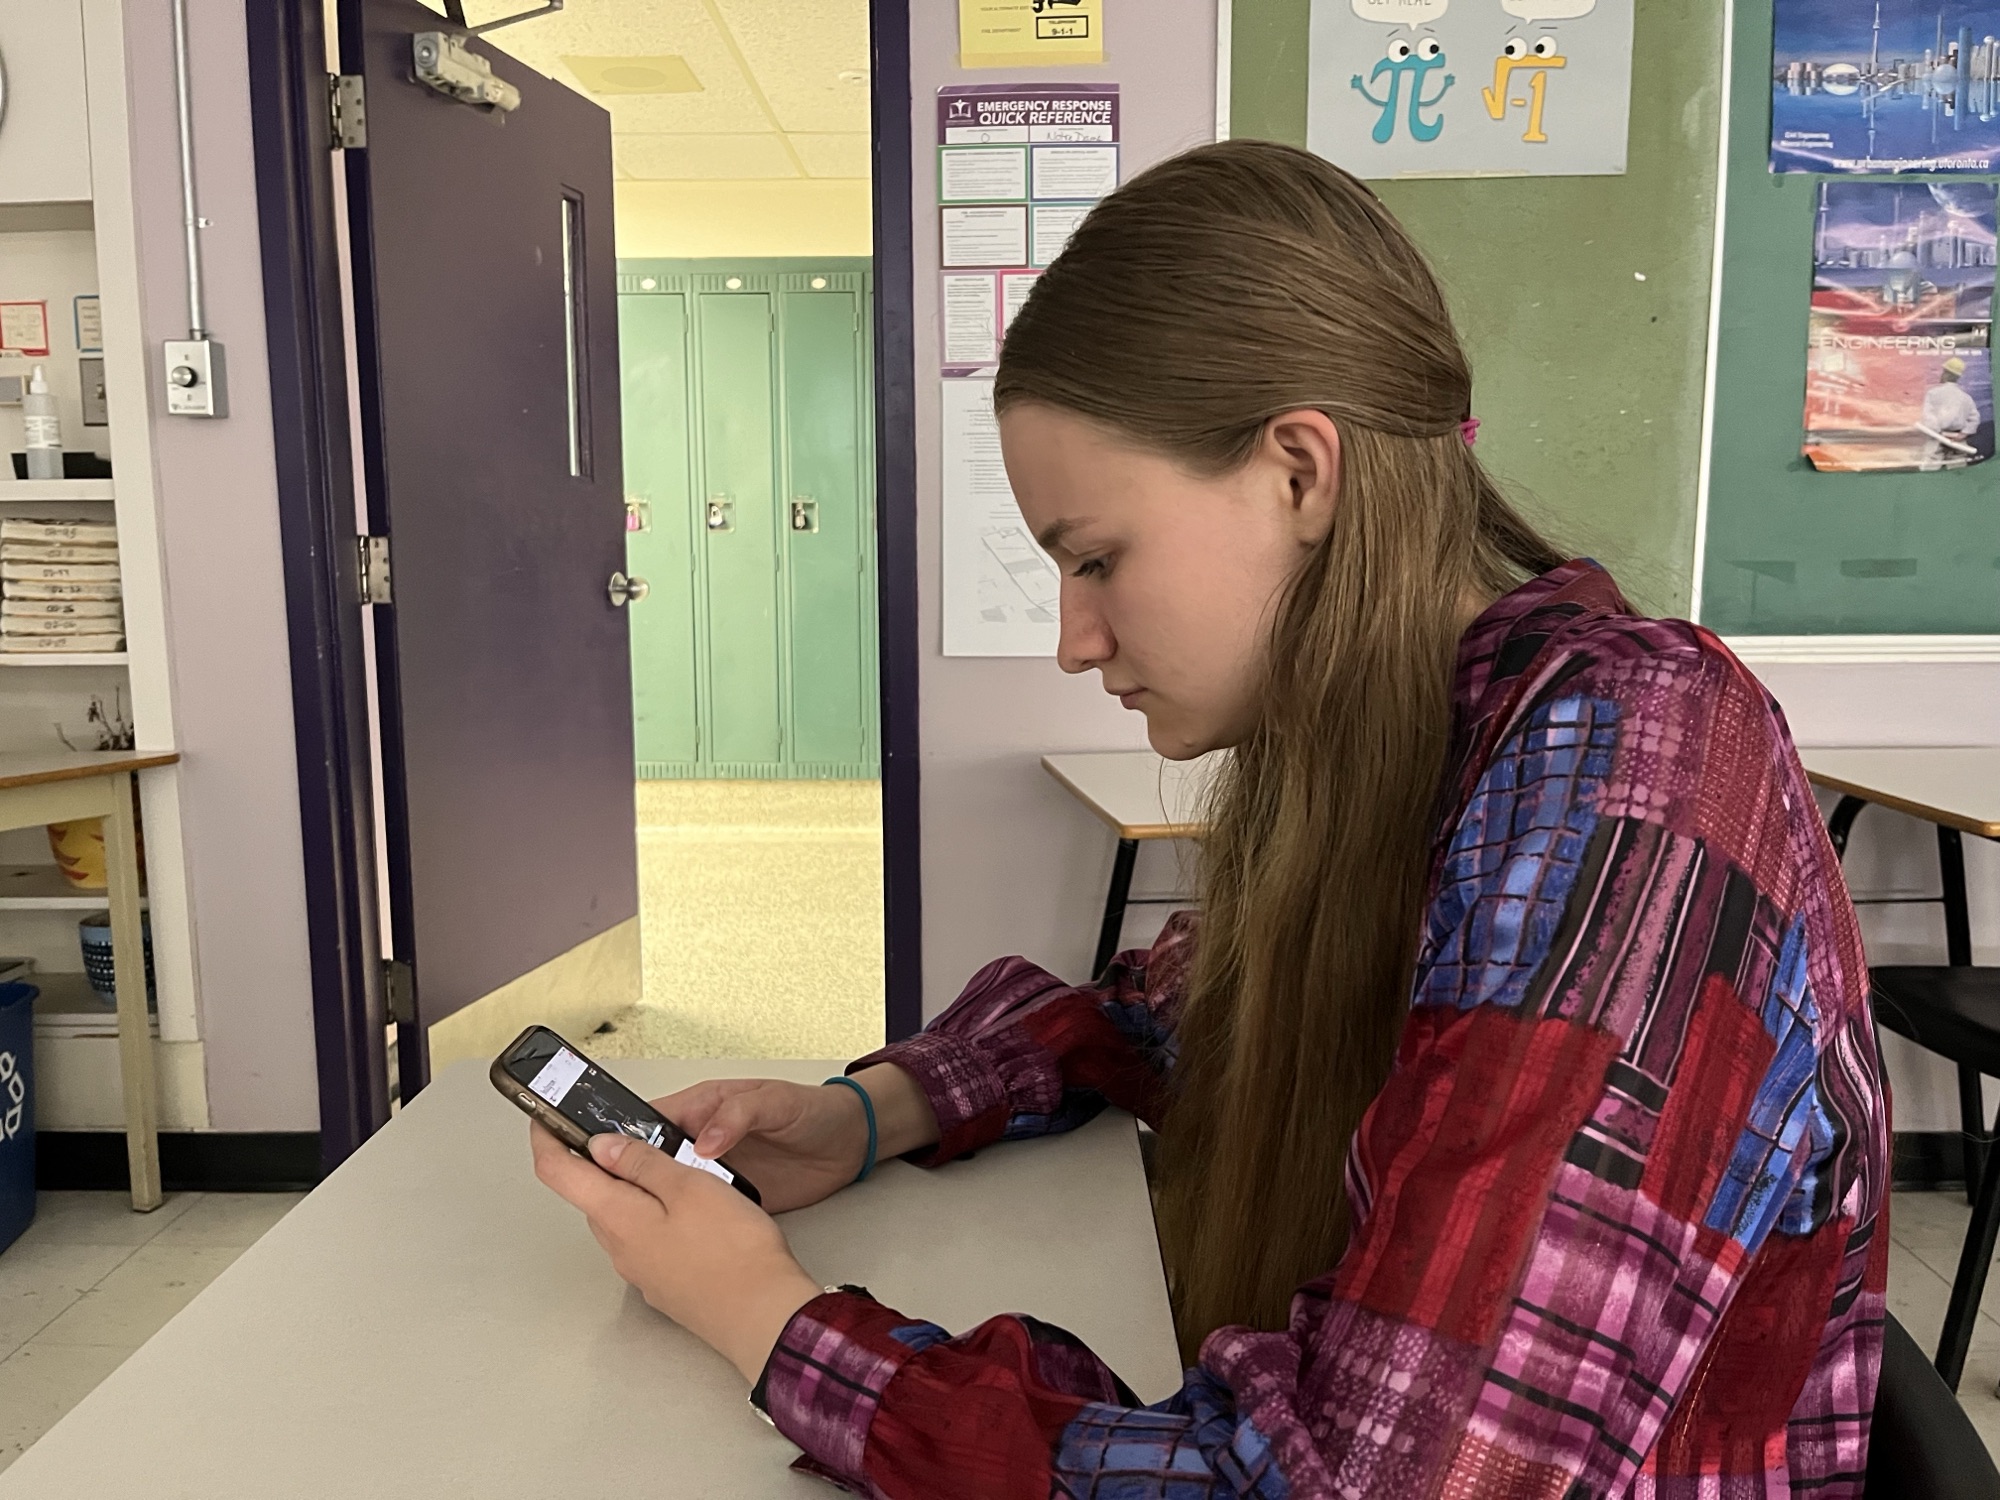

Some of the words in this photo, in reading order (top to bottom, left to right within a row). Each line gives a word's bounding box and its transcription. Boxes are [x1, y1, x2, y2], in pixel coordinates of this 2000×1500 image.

[1051, 28, 1073, 36] 9-1-1
[977, 101, 1049, 111] EMERGENCY
[1052, 100, 1112, 111] RESPONSE
[979, 112, 1026, 125] QUICK
[1029, 111, 1112, 124] REFERENCE
[1821, 335, 1956, 350] ENGINEERING
